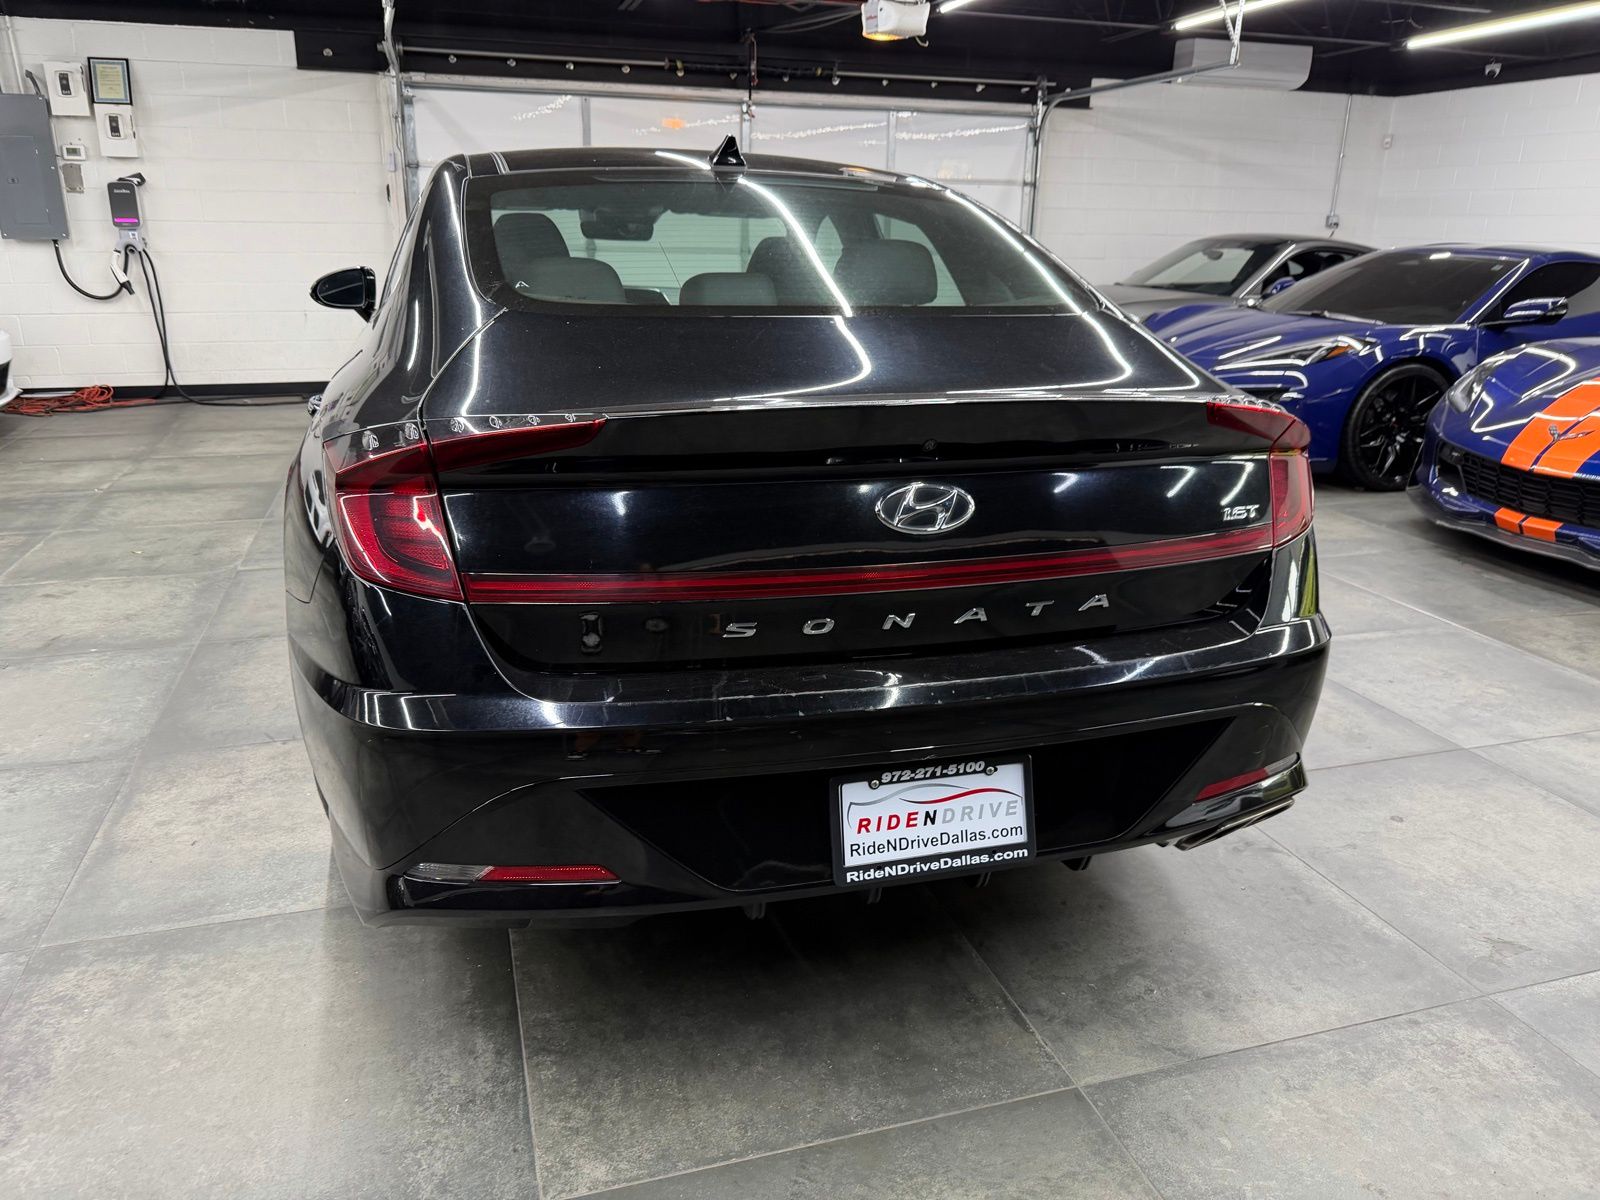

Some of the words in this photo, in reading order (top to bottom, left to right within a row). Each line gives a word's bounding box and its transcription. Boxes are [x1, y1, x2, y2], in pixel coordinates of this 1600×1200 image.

[722, 593, 1110, 639] SONATA
[881, 760, 986, 784] 972-271-5100
[850, 825, 1023, 857] RideNDriveDallas.com
[846, 848, 1029, 883] RideNDriveDallas.com
